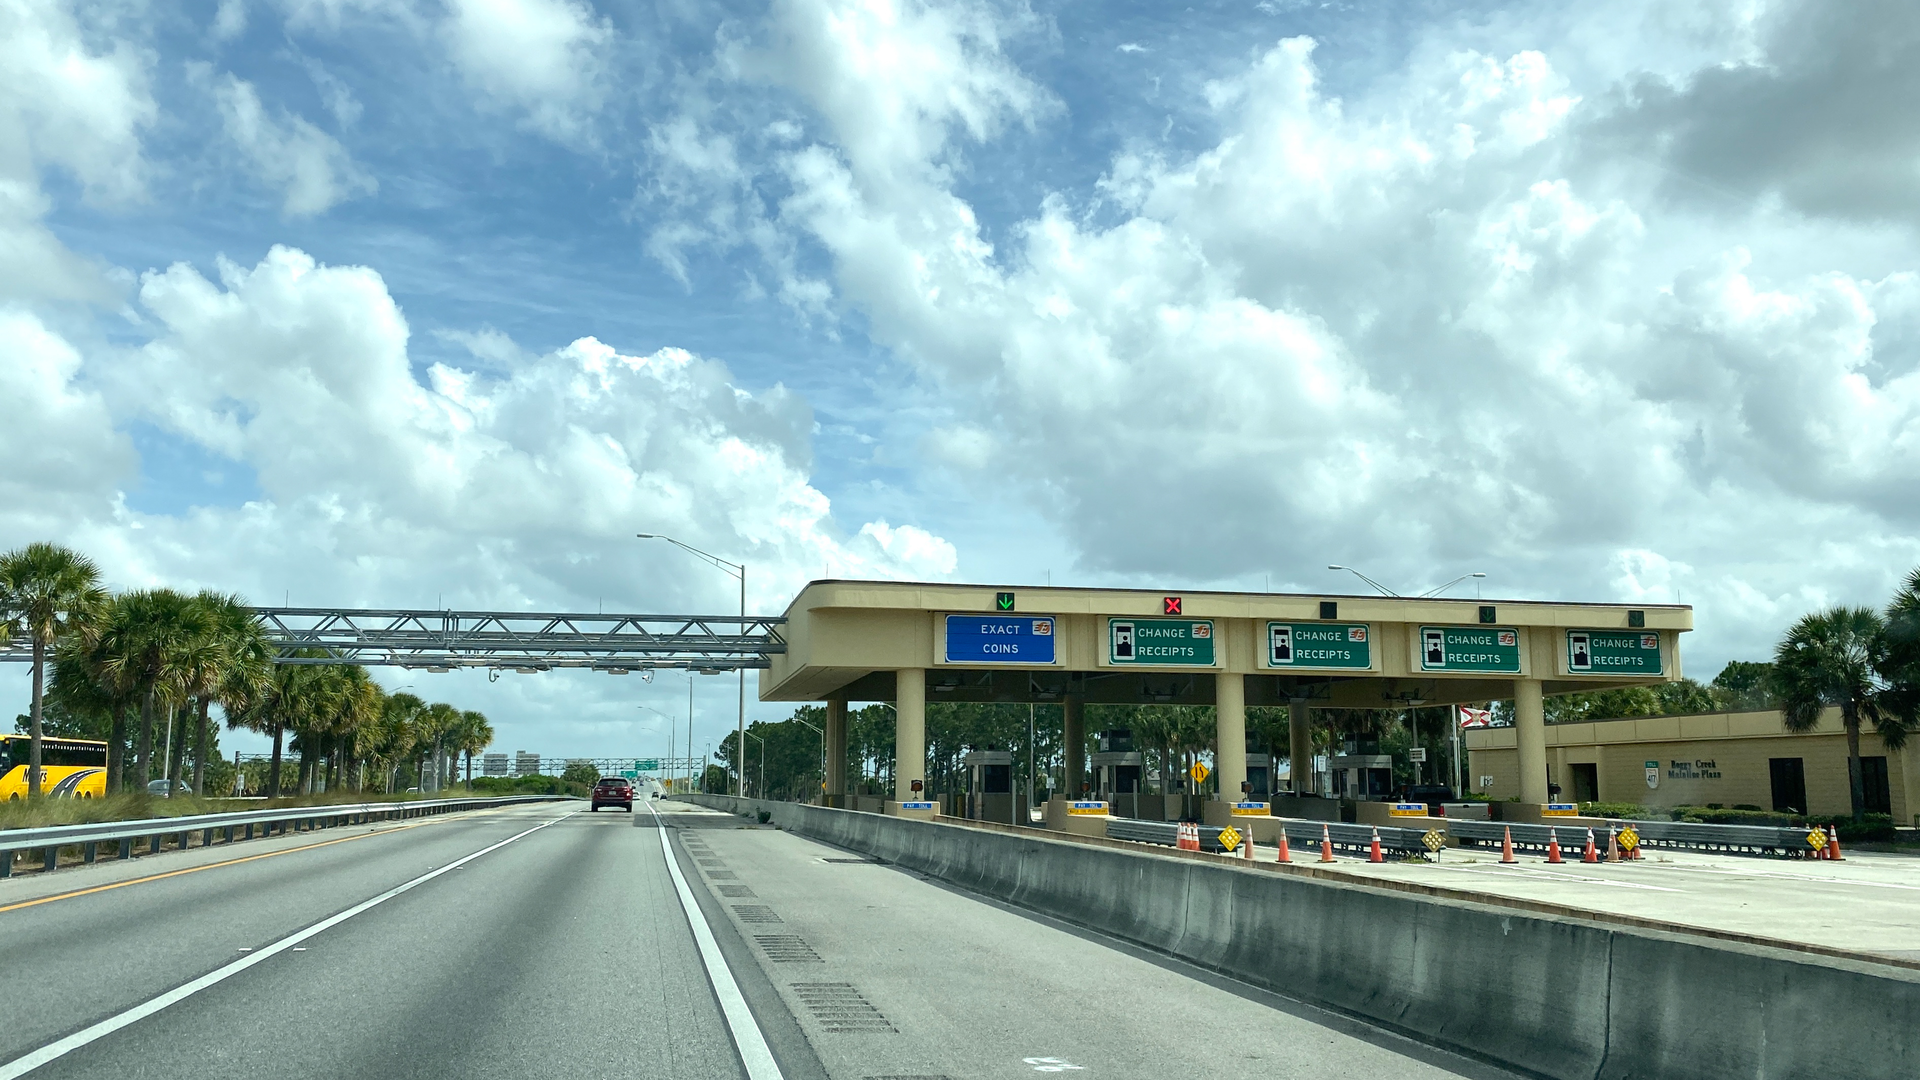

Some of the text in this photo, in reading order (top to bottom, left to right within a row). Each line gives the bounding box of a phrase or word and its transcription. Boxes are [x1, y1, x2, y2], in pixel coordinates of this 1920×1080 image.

[981, 625, 1020, 635] EXACT
[1138, 628, 1186, 638] CHANGE
[1295, 631, 1342, 641] CHANGE
[1447, 635, 1492, 645] CHANGE
[983, 643, 1019, 654] COINS
[1592, 638, 1635, 649] CHANGE
[1138, 646, 1195, 656] RECEIPTS
[1296, 649, 1351, 660] RECEIPTS
[1448, 653, 1501, 664] RECEIPTS
[1593, 656, 1644, 666] RECEIPTS
[1695, 759, 1716, 768] Creek
[1701, 770, 1721, 779] Plaza
